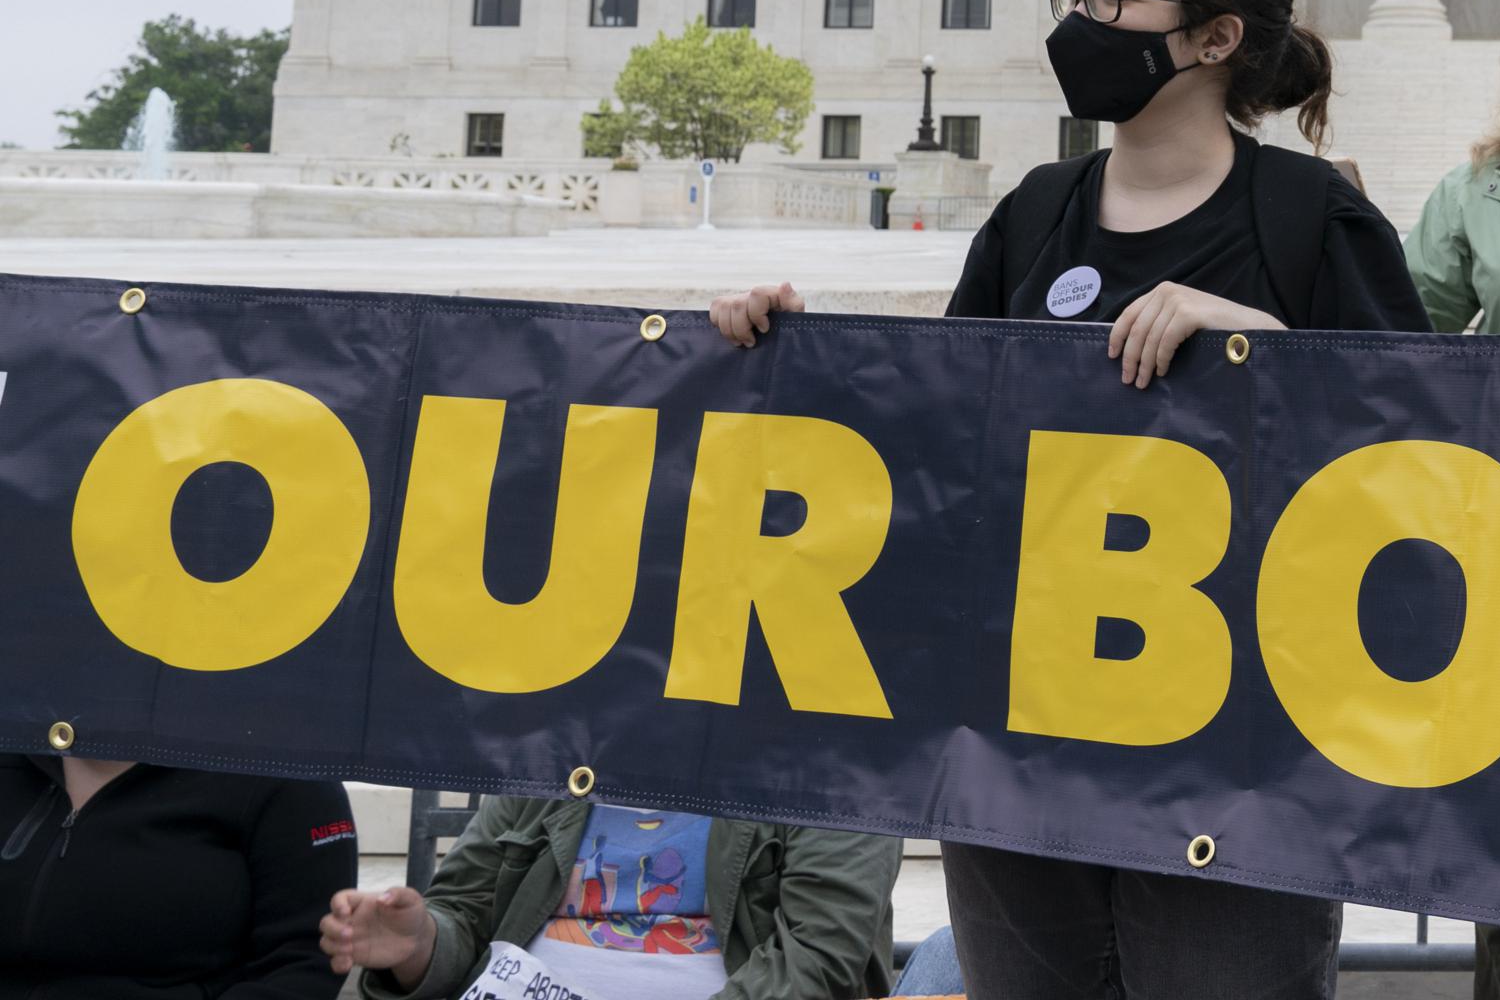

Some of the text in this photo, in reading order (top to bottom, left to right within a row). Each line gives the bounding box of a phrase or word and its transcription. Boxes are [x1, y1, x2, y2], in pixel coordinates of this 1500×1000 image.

[1143, 49, 1156, 74] enro
[1053, 283, 1094, 299] OFF OUR
[1054, 279, 1079, 291] BANS
[1051, 292, 1088, 307] BODIES
[72, 378, 893, 719] OUR
